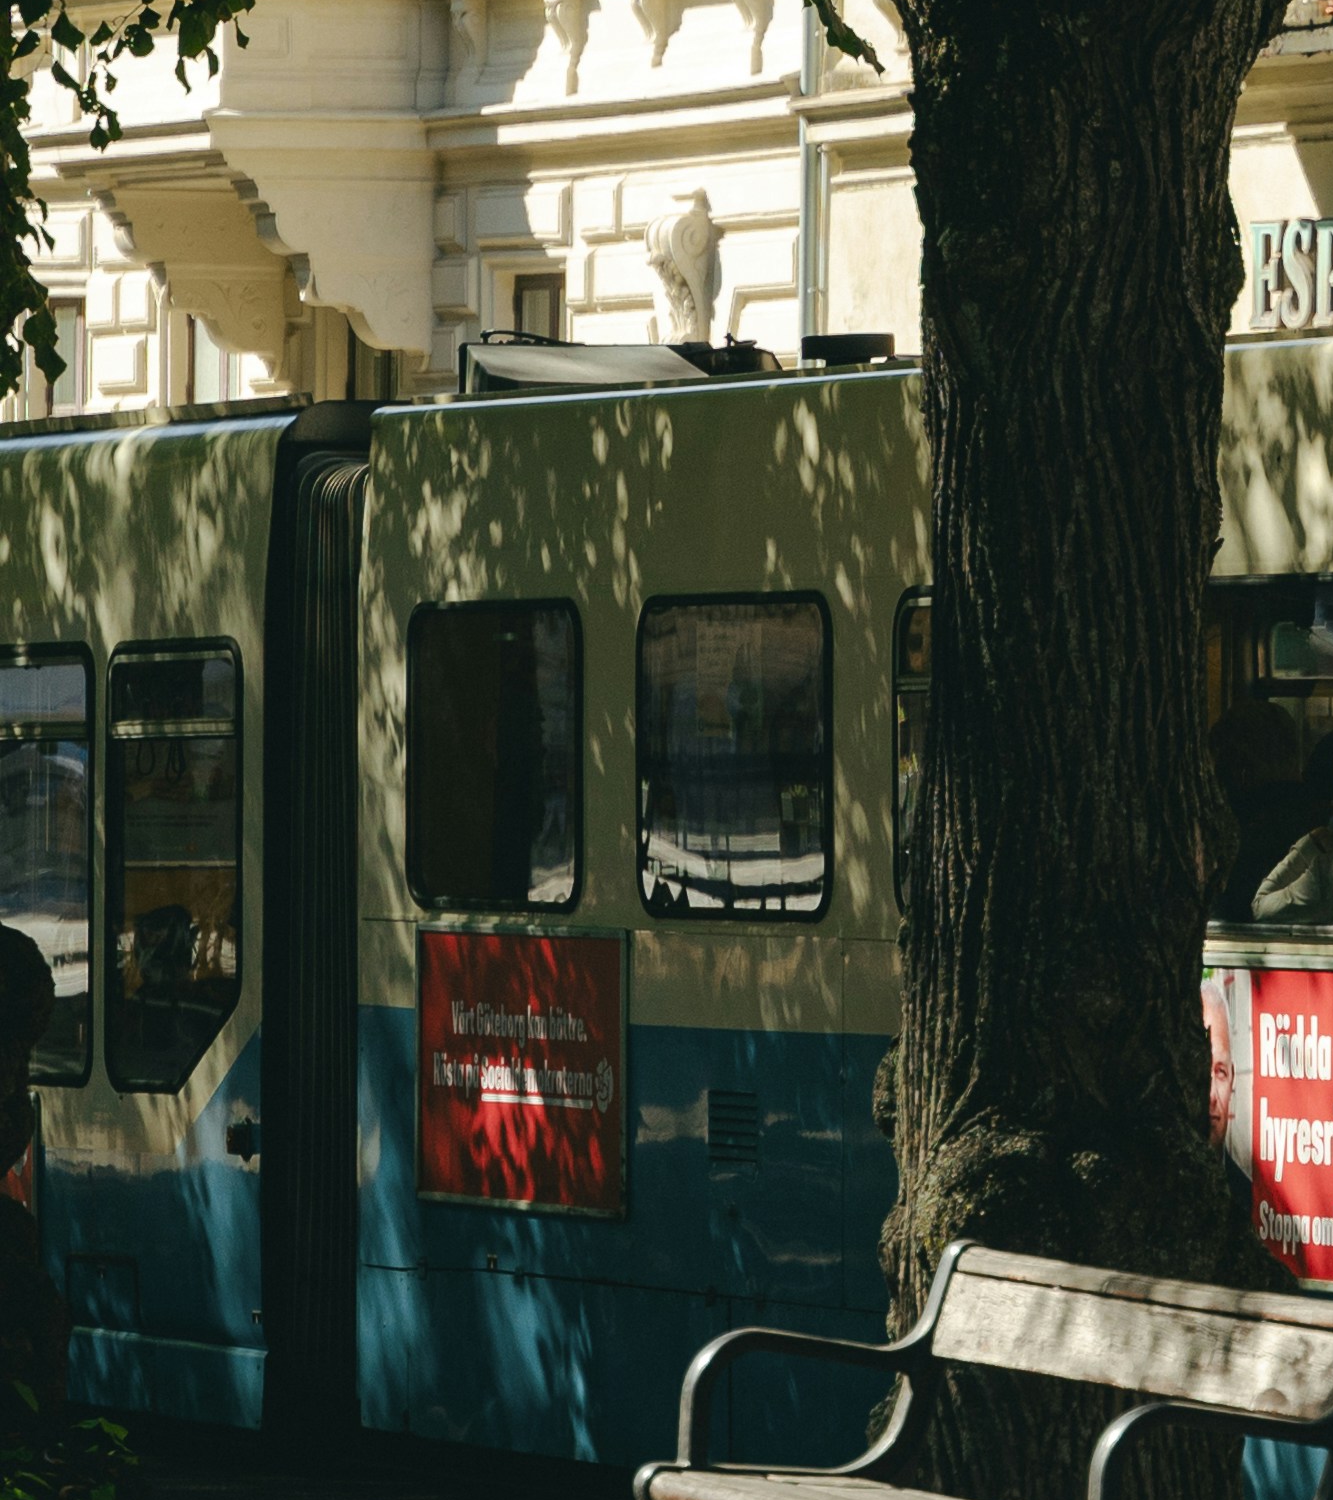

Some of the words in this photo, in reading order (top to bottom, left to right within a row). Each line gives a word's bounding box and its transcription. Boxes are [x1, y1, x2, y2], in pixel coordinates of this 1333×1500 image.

[452, 1000, 475, 1034] Vårt
[476, 1001, 525, 1048] Göteborg
[527, 1004, 547, 1040] kan
[1259, 1012, 1332, 1081] Rädda
[433, 1051, 464, 1087] Rösta
[465, 1052, 479, 1098] på
[480, 1055, 593, 1096] Socialdemokraterna
[1258, 1200, 1310, 1255] Stoppa
